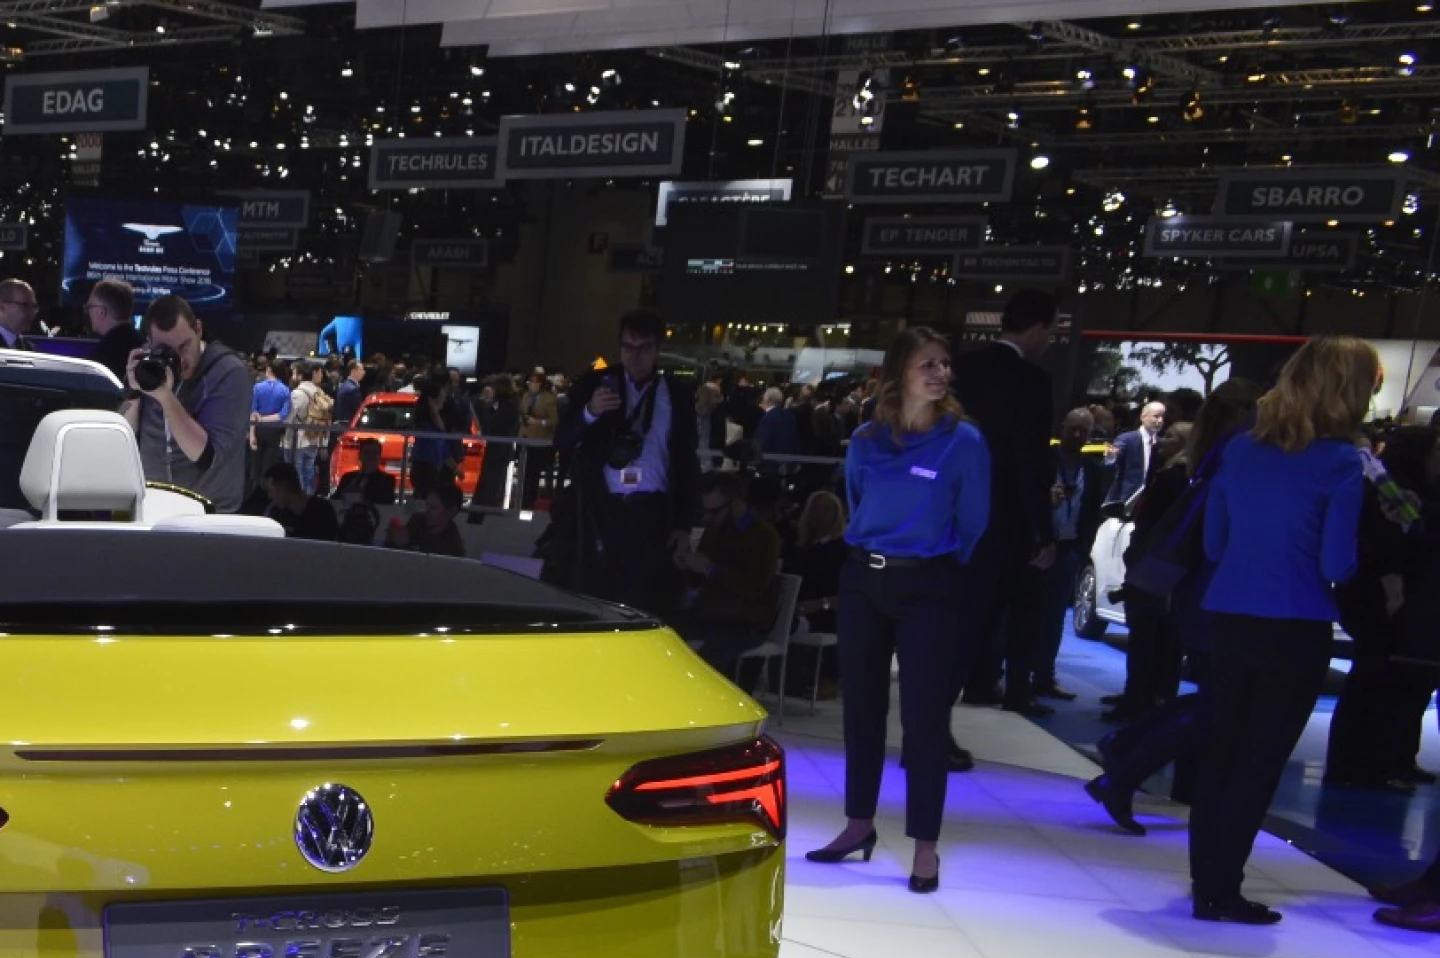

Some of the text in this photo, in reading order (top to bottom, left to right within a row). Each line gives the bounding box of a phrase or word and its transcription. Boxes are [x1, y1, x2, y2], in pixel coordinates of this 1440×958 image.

[42, 89, 104, 115] EDAG
[520, 131, 658, 156] ITALDESIGN
[388, 154, 489, 171] TECHRULES
[869, 165, 990, 188] TECHART
[1251, 186, 1365, 206] SBARRO
[242, 201, 280, 218] MTM
[594, 234, 604, 249] F
[880, 228, 968, 242] EP TENDER
[1160, 228, 1276, 242] SPYKER CARS
[427, 246, 470, 259] ARASH
[1293, 244, 1339, 258] UPSA
[232, 905, 400, 932] T-CROSS
